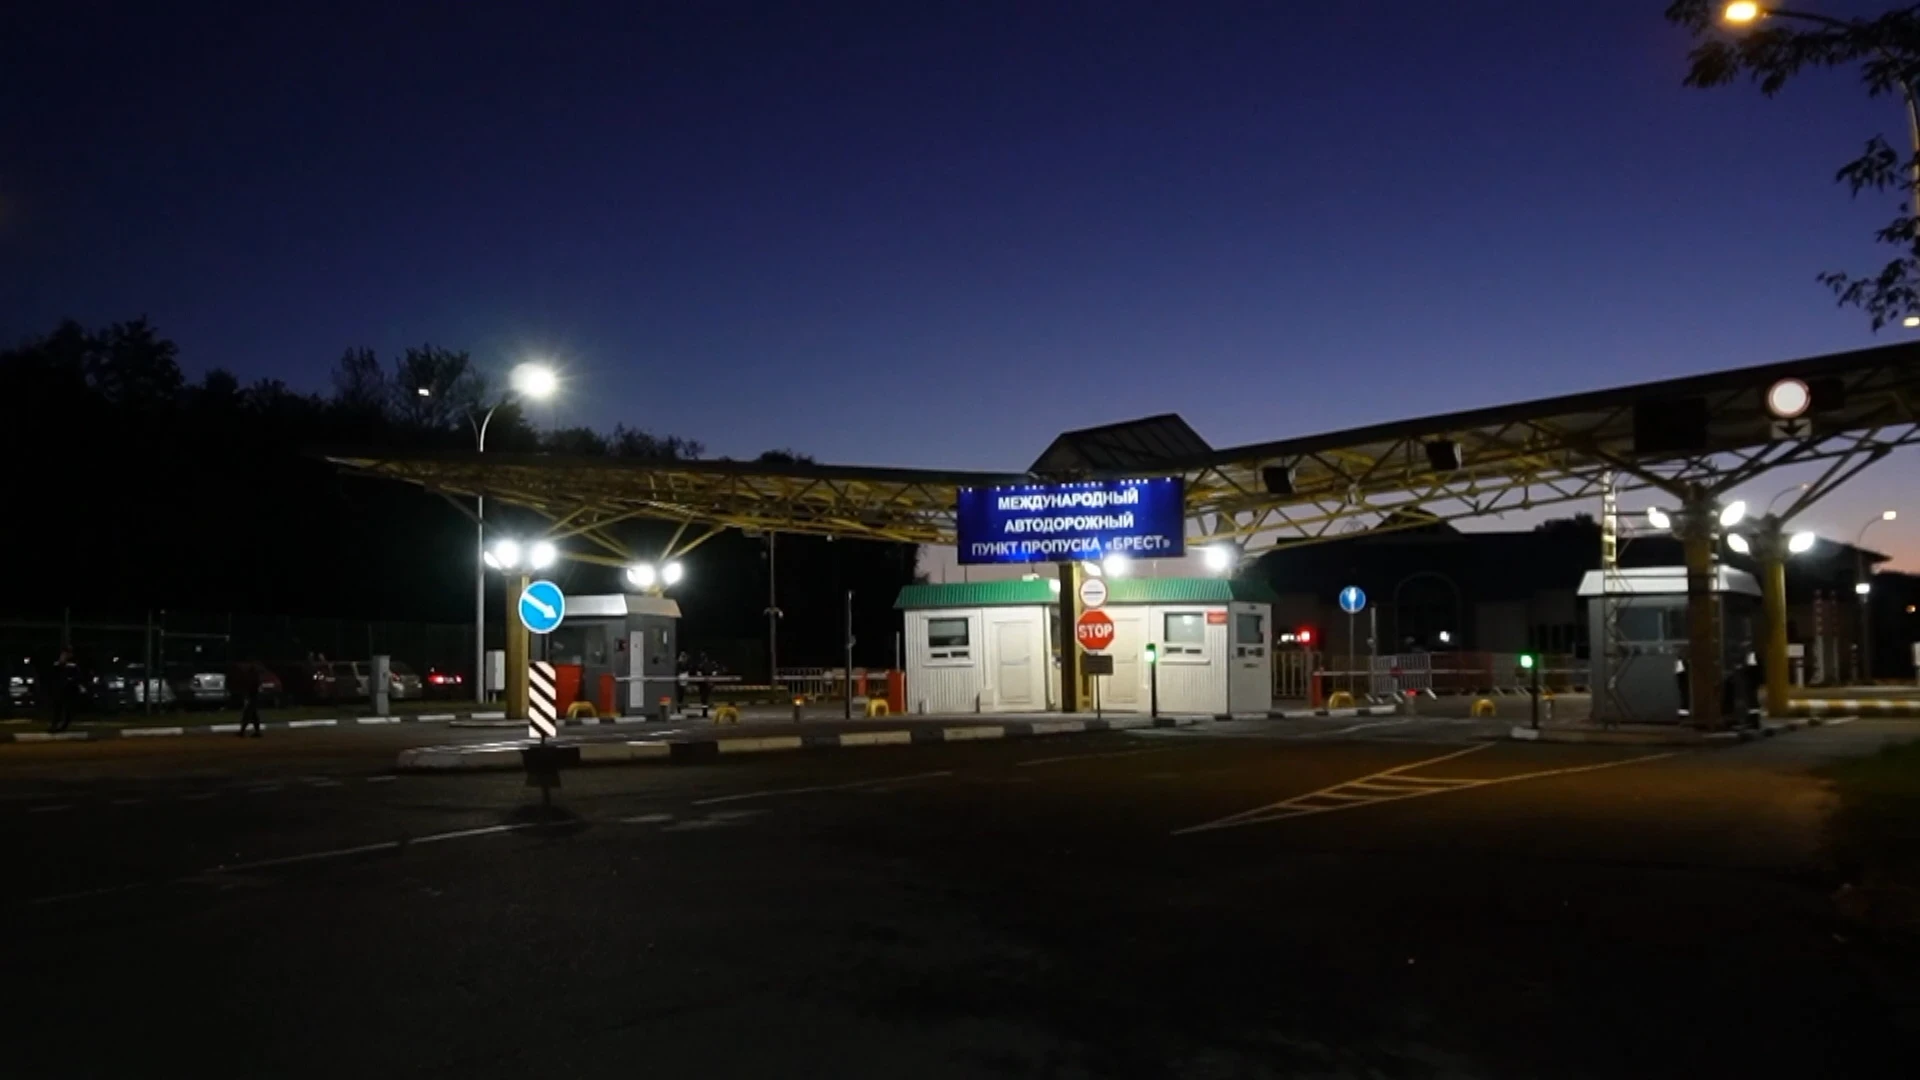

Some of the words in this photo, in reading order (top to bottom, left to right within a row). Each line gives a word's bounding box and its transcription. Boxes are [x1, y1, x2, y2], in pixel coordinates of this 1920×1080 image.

[998, 487, 1138, 511] МЕЖДУНАРОДНЫЙ
[1004, 512, 1133, 533] АВТОДОРОЖНЫЙ
[972, 541, 1018, 556] ПУНКТ
[1021, 538, 1100, 554] ПРОПУСКА
[1105, 535, 1171, 551] «БРЕСТ»
[1078, 624, 1112, 639] STOP
